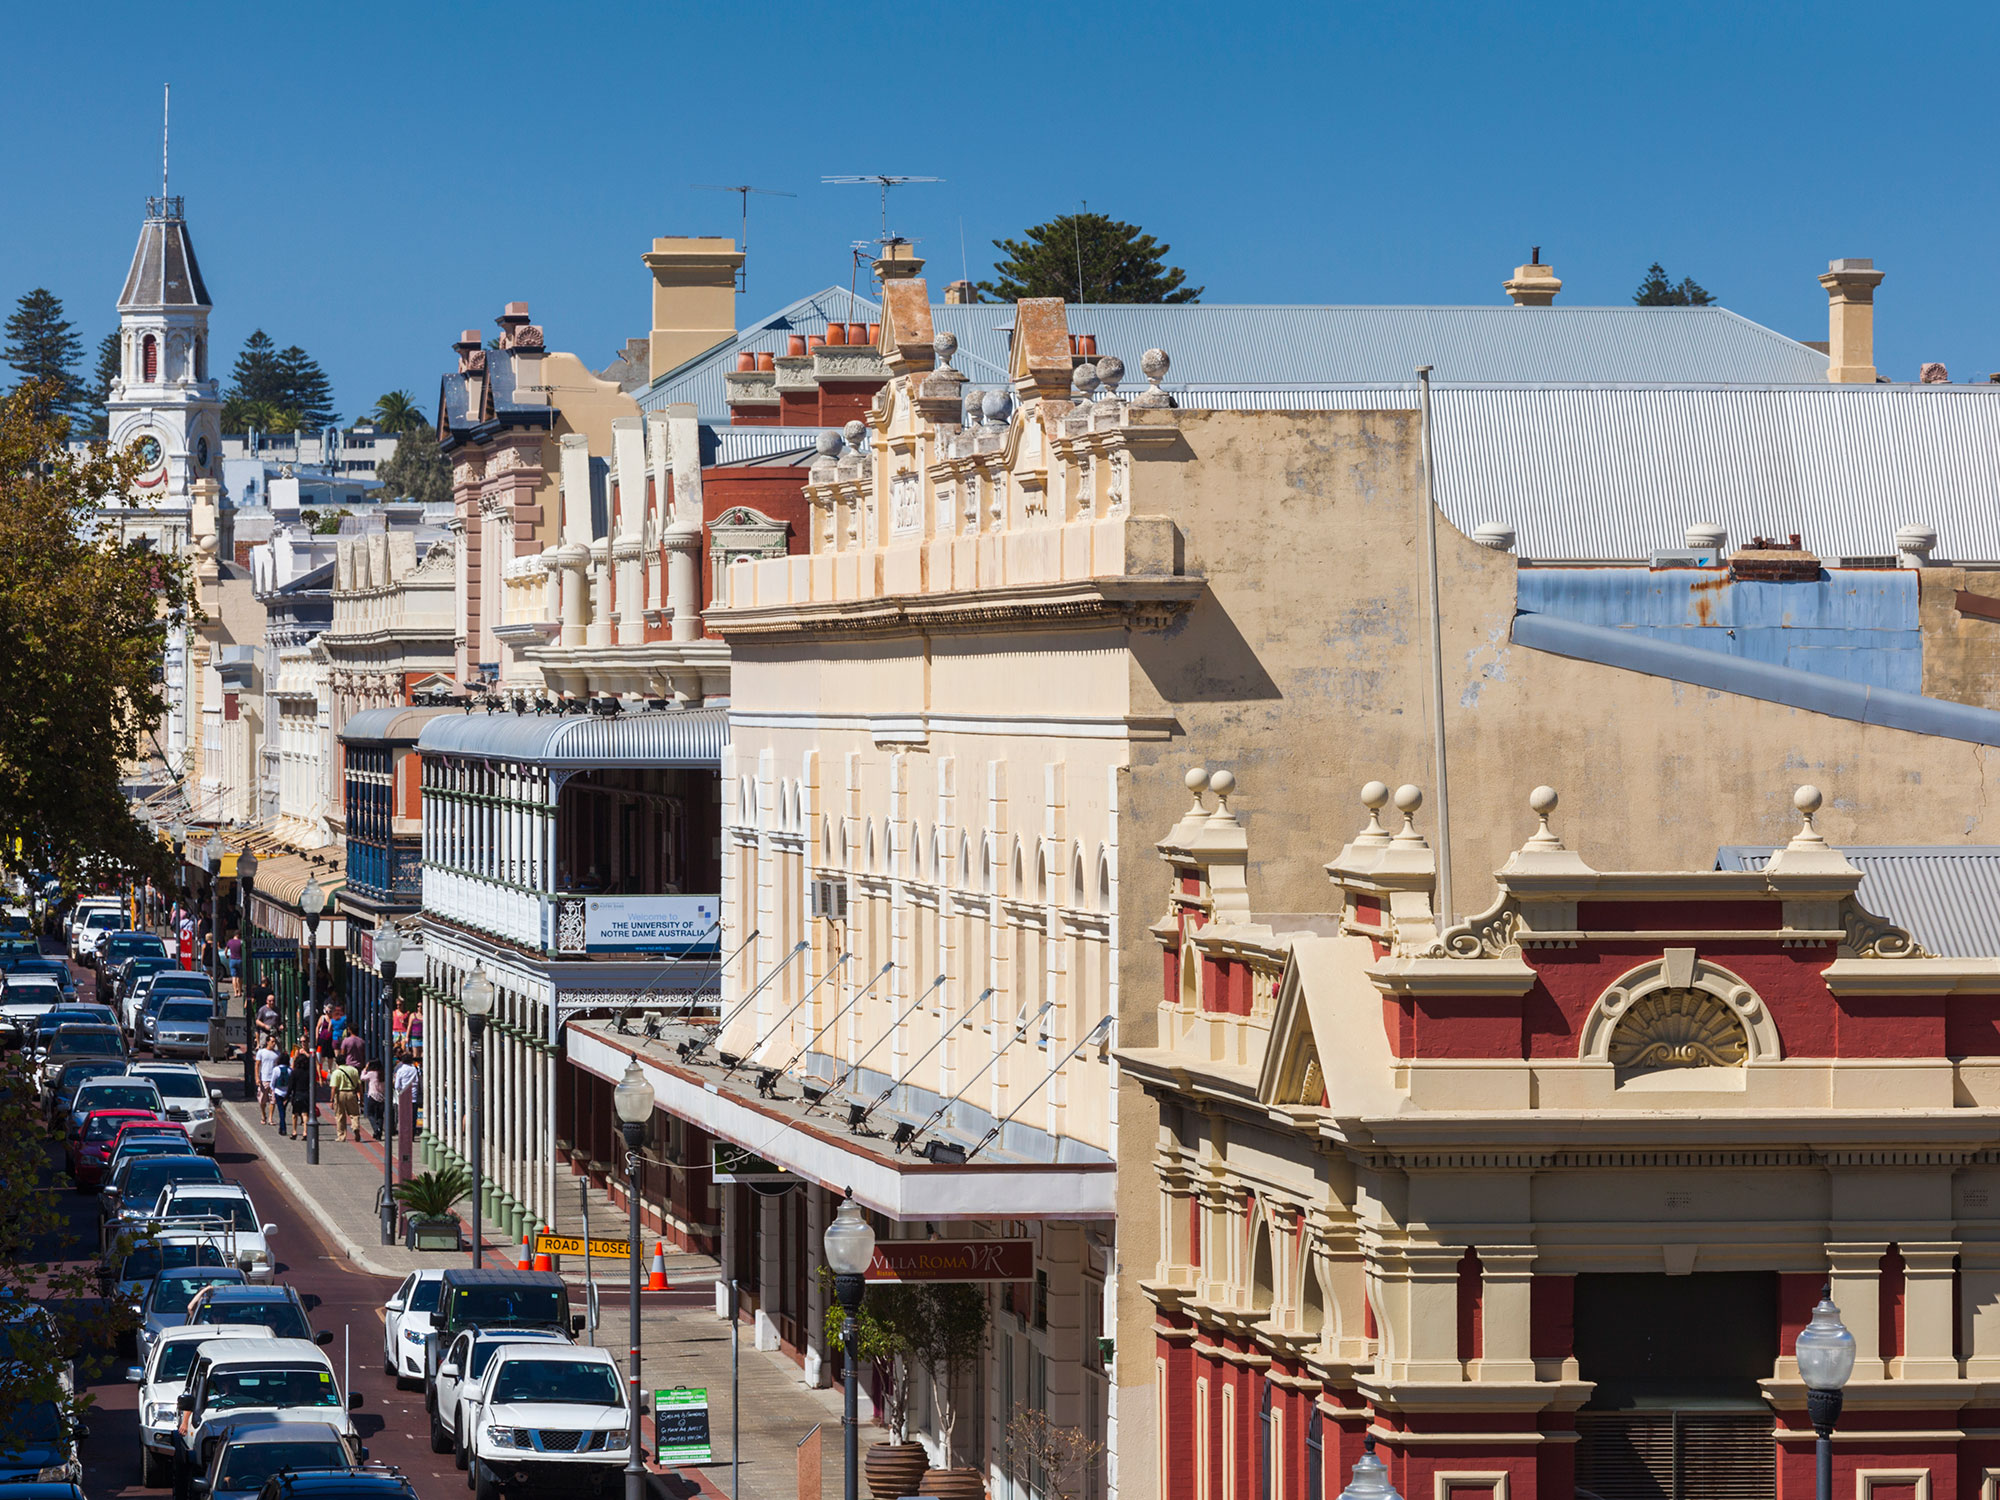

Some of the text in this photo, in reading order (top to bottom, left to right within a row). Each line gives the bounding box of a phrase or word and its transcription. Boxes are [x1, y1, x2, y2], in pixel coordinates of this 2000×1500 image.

[612, 921, 694, 930] THE UNIVERSITY OF
[600, 929, 705, 938] NOTRE DAME AUSTRALIA
[544, 1239, 579, 1251] ROAD
[872, 1255, 917, 1270] VILLA
[919, 1254, 968, 1269] ROMA
